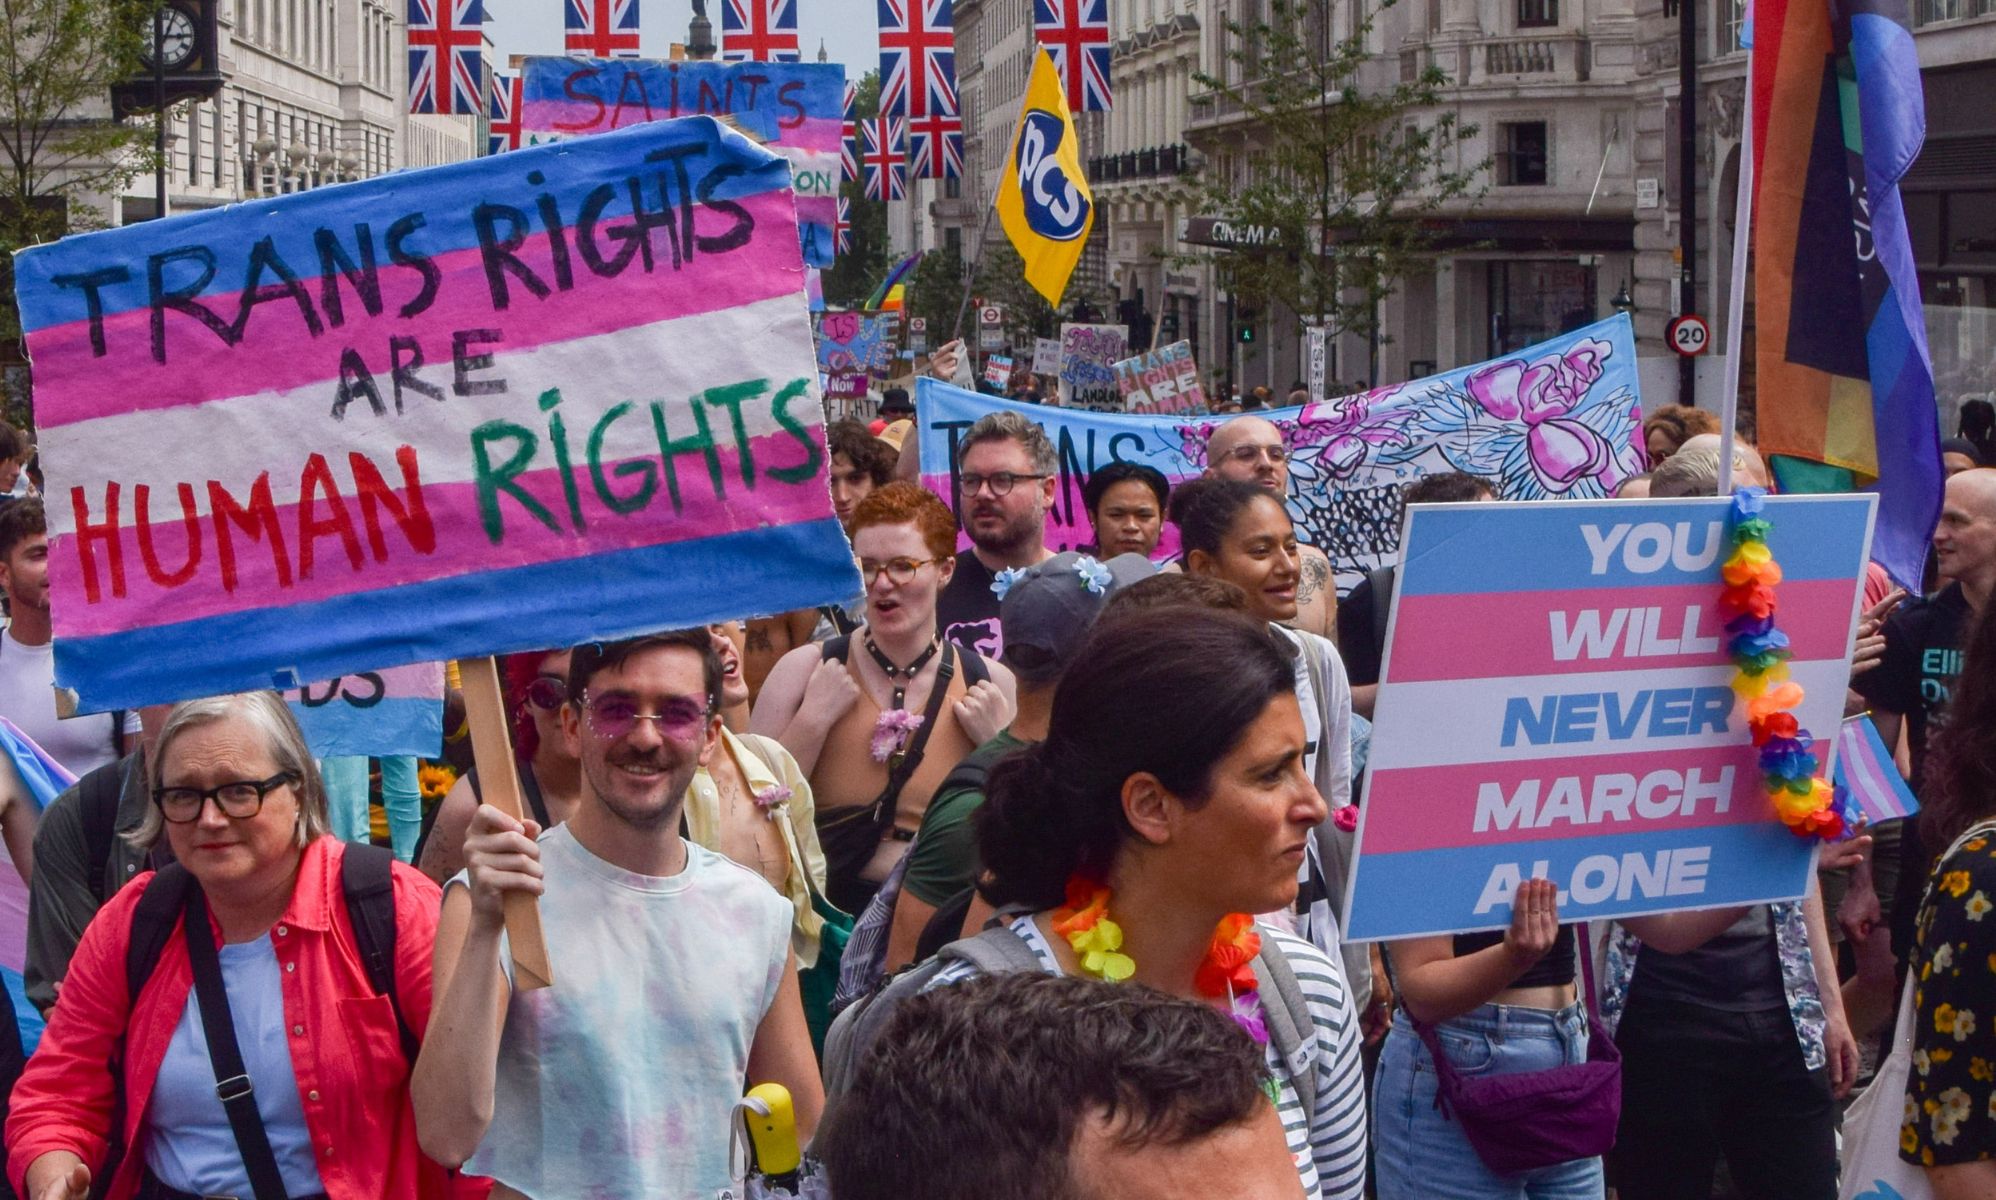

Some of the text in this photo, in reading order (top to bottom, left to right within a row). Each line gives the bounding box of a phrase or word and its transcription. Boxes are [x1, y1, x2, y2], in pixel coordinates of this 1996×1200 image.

[552, 63, 807, 131] SAINTS
[50, 141, 756, 365] TRANS RIGHTS
[1677, 327, 1705, 344] 20
[330, 328, 508, 421] ARE
[1126, 371, 1200, 412] ARE
[70, 376, 824, 604] HUMAN RIGHTS
[1580, 520, 1723, 576] YOU
[1548, 605, 1720, 662] WILL
[1500, 684, 1737, 749] NEVER
[1472, 764, 1737, 834] MARCH
